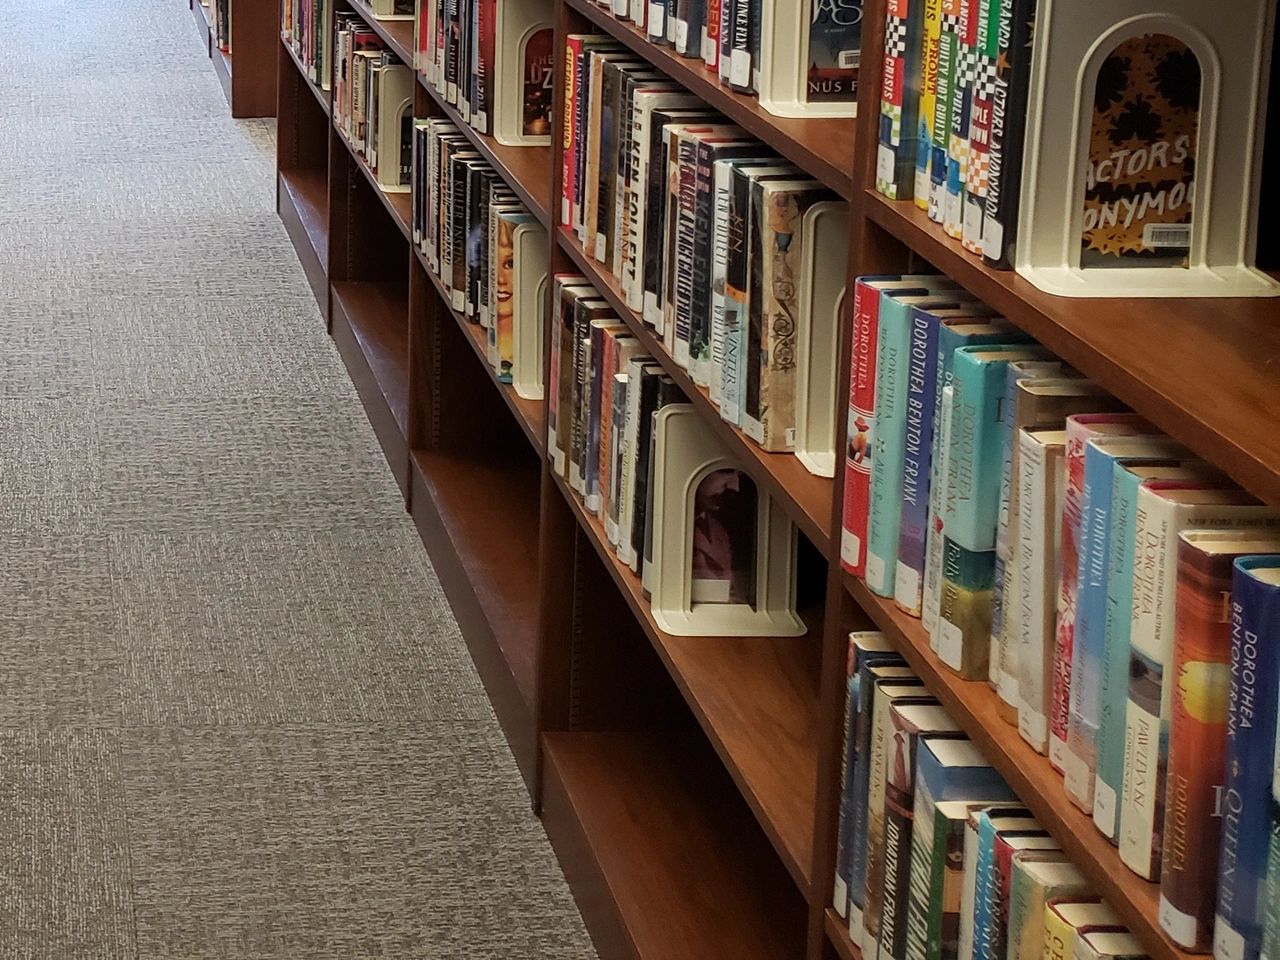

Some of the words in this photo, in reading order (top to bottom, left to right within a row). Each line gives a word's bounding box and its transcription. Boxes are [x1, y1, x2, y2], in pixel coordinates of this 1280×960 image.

[720, 8, 729, 46] FLYNN
[883, 57, 896, 100] CRISIS
[936, 73, 948, 99] NOT
[992, 75, 1010, 137] ACTORS
[933, 100, 948, 145] GUILTY
[950, 89, 965, 133] PULSE
[629, 140, 641, 184] KEN
[1086, 134, 1191, 191] ACTORS
[624, 190, 639, 281] FOLLETT
[715, 215, 728, 266] FOLLETT
[857, 313, 871, 391] DOROTHEA
[908, 316, 929, 394] DOROTHEA
[934, 350, 945, 407] BENTON
[884, 347, 898, 420] DOROTHEA
[905, 394, 923, 454] BENTON
[958, 402, 977, 502] DOROTHEA
[903, 456, 919, 507] FRANK
[1090, 507, 1107, 589] DOROTHEA
[1142, 531, 1159, 616] DOROTHEA
[1230, 601, 1243, 668] BENTON
[1239, 630, 1258, 730] DOROTHEA
[885, 816, 900, 892] JONATHAN
